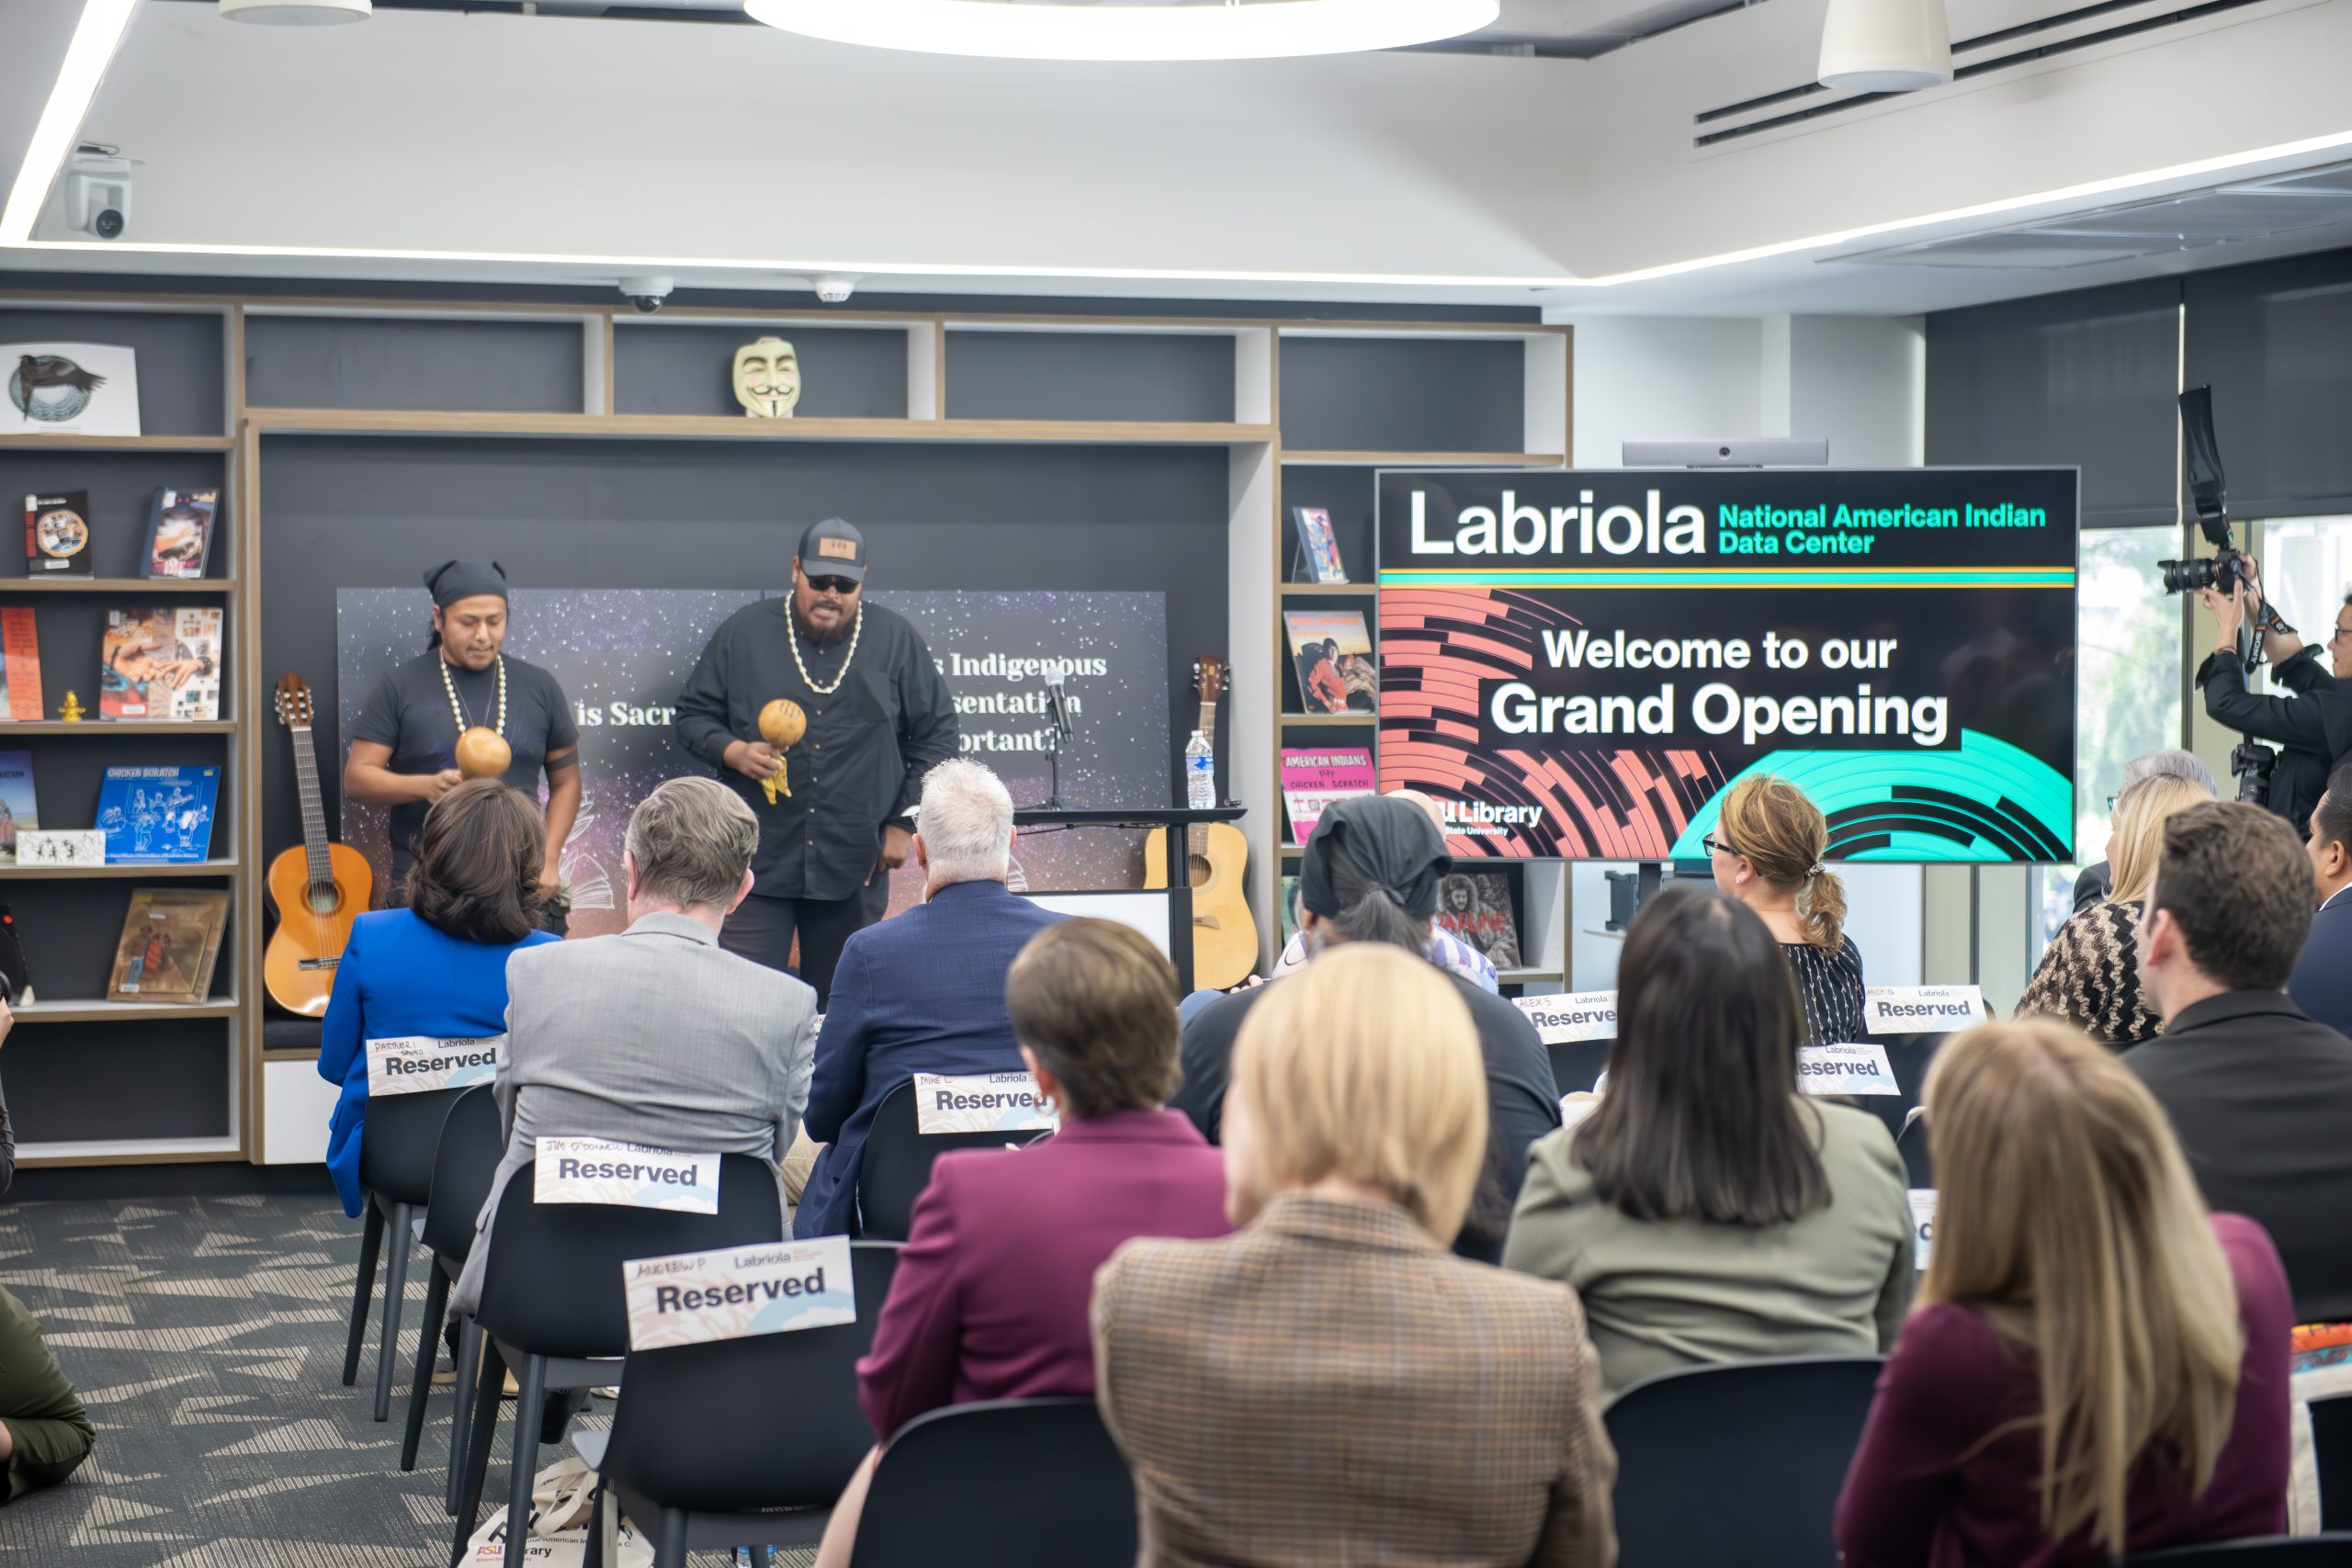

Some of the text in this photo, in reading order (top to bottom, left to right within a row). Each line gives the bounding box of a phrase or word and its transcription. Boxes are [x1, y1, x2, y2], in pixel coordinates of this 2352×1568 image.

[1411, 490, 1706, 555] Labriola
[1719, 502, 2046, 528] National American Indian
[1719, 529, 1875, 554] Data Center
[1542, 629, 1897, 669] Welcome to our
[2251, 631, 2263, 664] SONY
[949, 653, 1108, 682] Indigenous
[952, 691, 1082, 714] sentatin
[577, 701, 677, 727] is Sacr
[1491, 682, 1948, 747] Grand Opening
[958, 727, 1061, 751] ortant?
[1286, 755, 1367, 768] AMERICAN INDIANS
[107, 767, 179, 778] CHICKEN SCRATCH
[1332, 780, 1369, 789] SCRATCH
[1459, 801, 1543, 828] Library
[1444, 827, 1509, 836] State University
[1520, 998, 1543, 1008] ALEX
[1575, 996, 1608, 1004] Labriola
[1877, 1000, 1971, 1017] Reserved
[1531, 1010, 1617, 1029] Reserve
[437, 1038, 475, 1049] Labriola
[1826, 1045, 1857, 1055] Labriola
[386, 1048, 496, 1076] Reserved
[1799, 1060, 1880, 1076] eserved
[989, 1073, 1027, 1084] Labriola
[559, 1158, 698, 1186] Reserved
[734, 1251, 791, 1269] Labriola
[656, 1267, 826, 1314] Reserved
[476, 1545, 552, 1558] ASU rary
